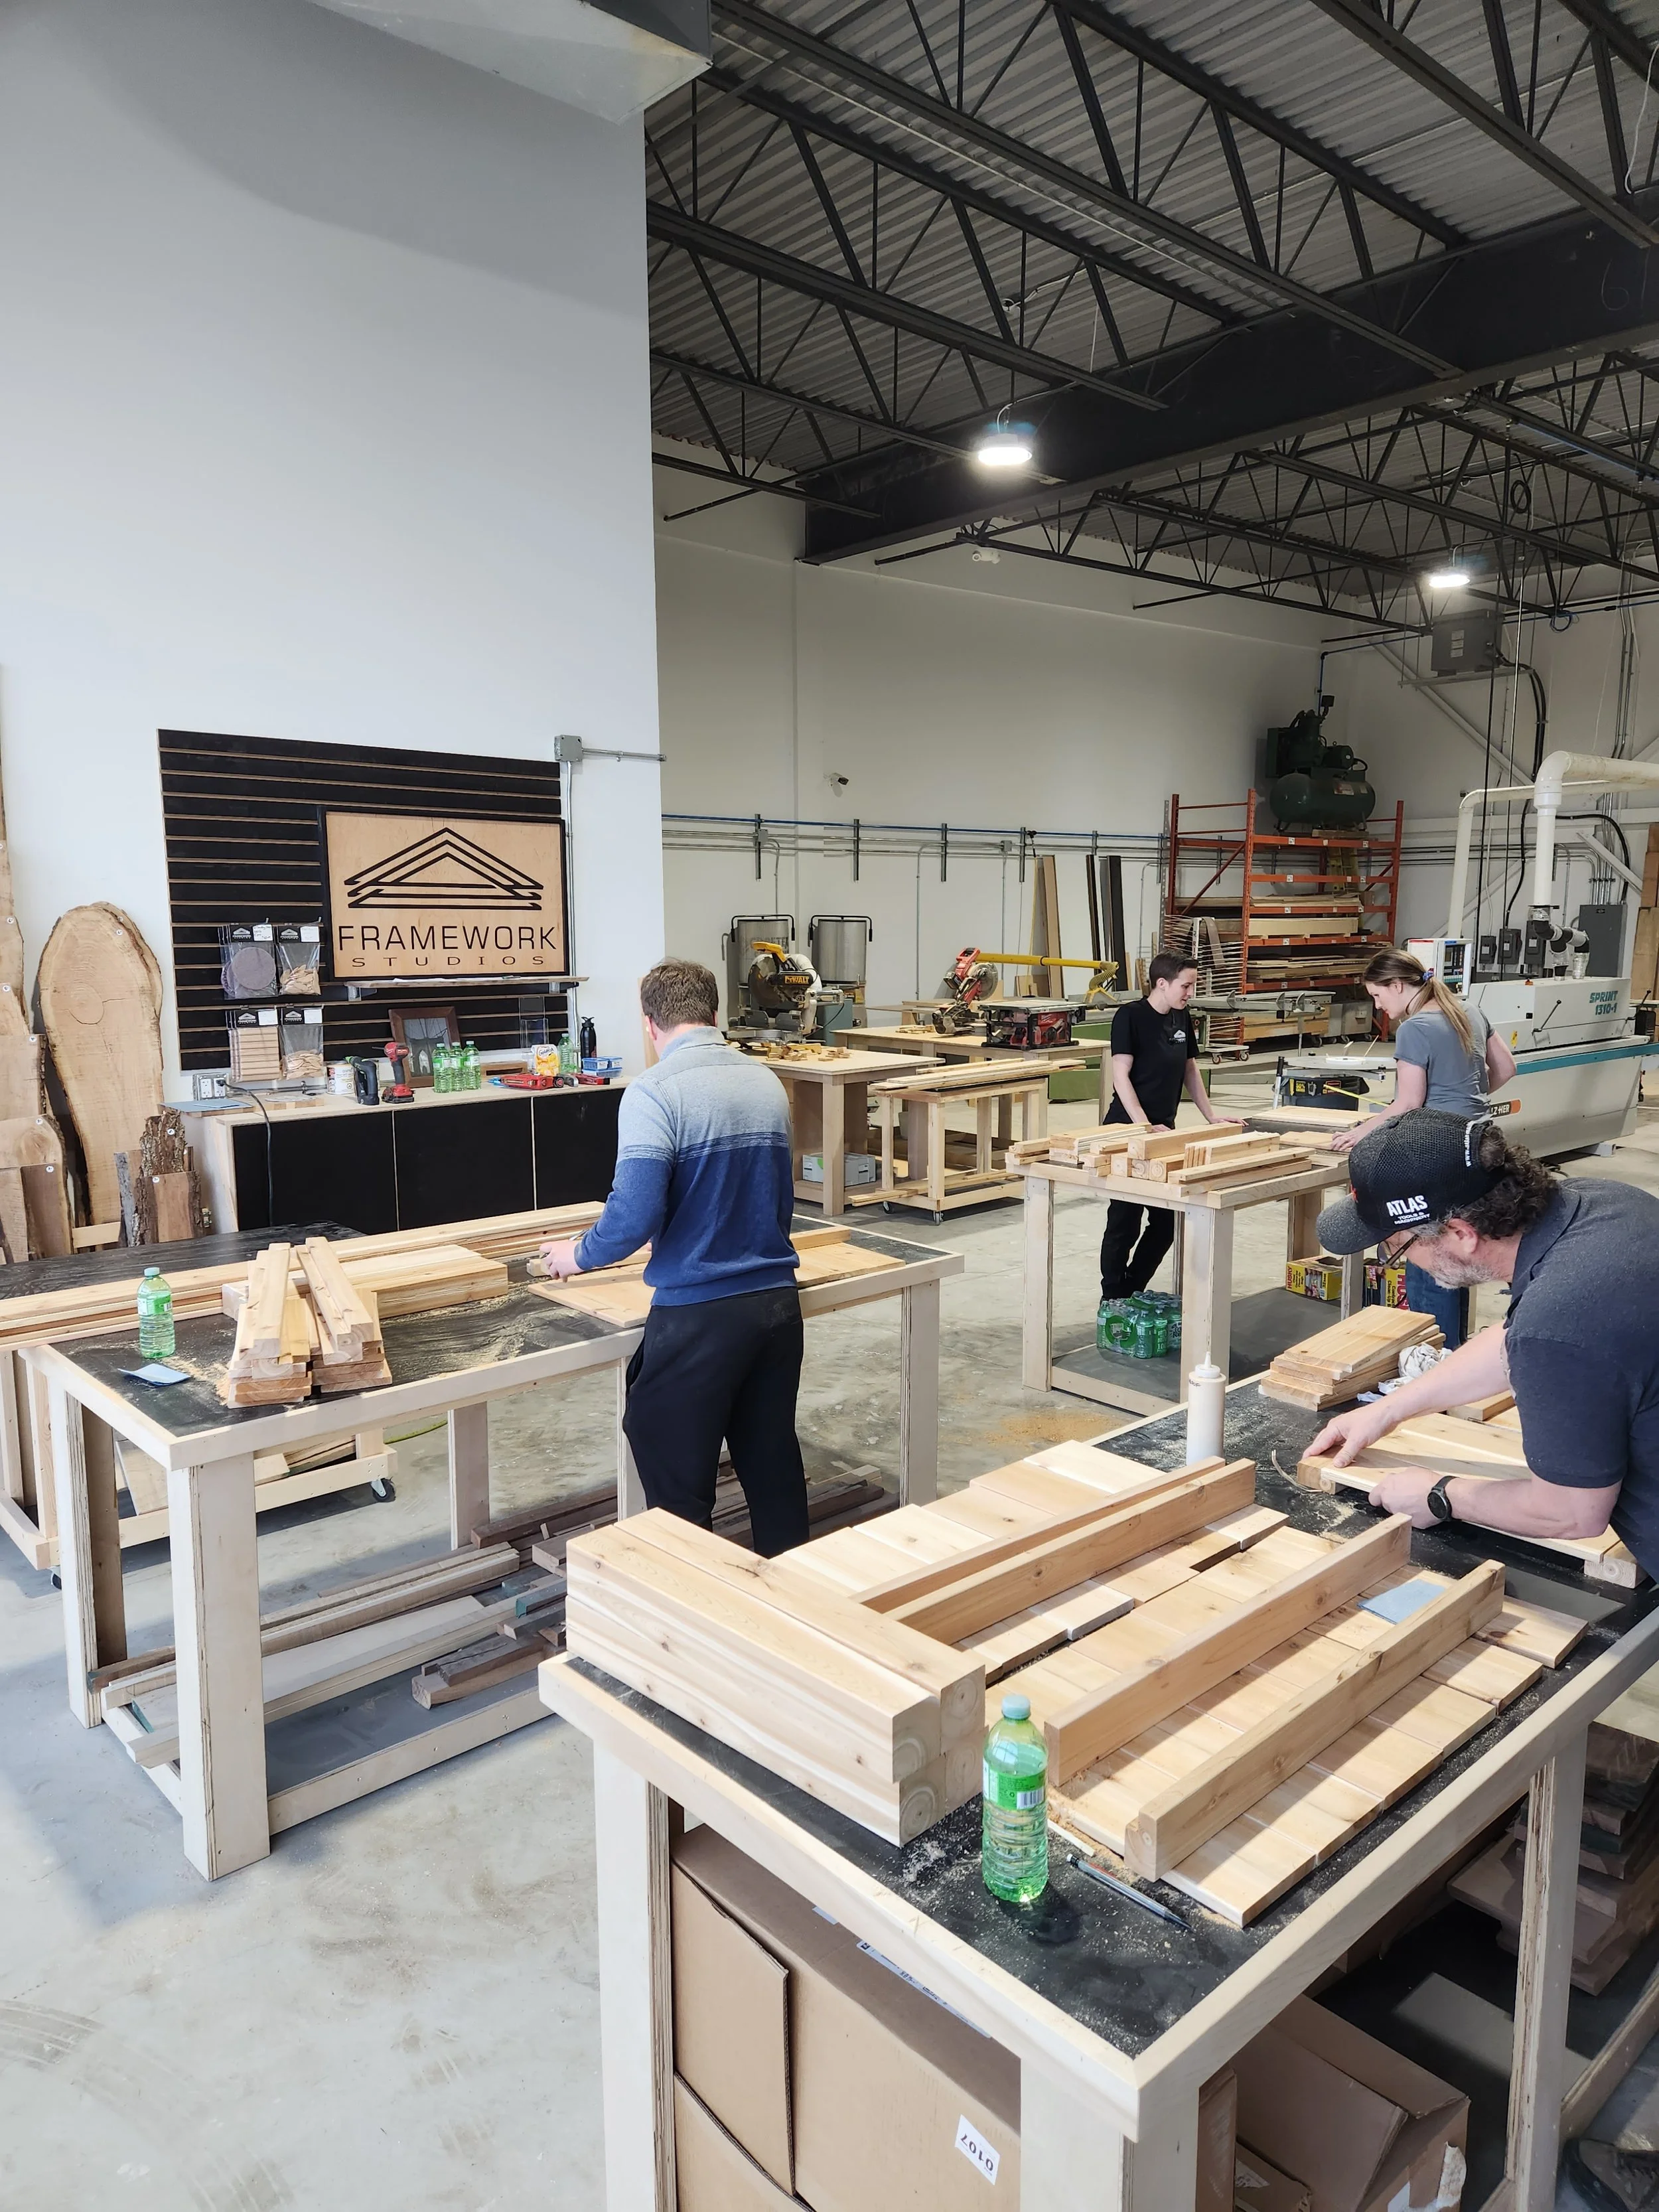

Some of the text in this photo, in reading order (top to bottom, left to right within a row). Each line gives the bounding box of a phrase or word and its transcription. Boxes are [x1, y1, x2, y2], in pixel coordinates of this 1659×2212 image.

[338, 925, 557, 950] FRAMEWORK
[352, 956, 544, 967] STUDIOS
[1589, 990, 1619, 1003] SPRINT
[1386, 1195, 1428, 1217] ATLAS
[960, 2134, 994, 2172] 0107
